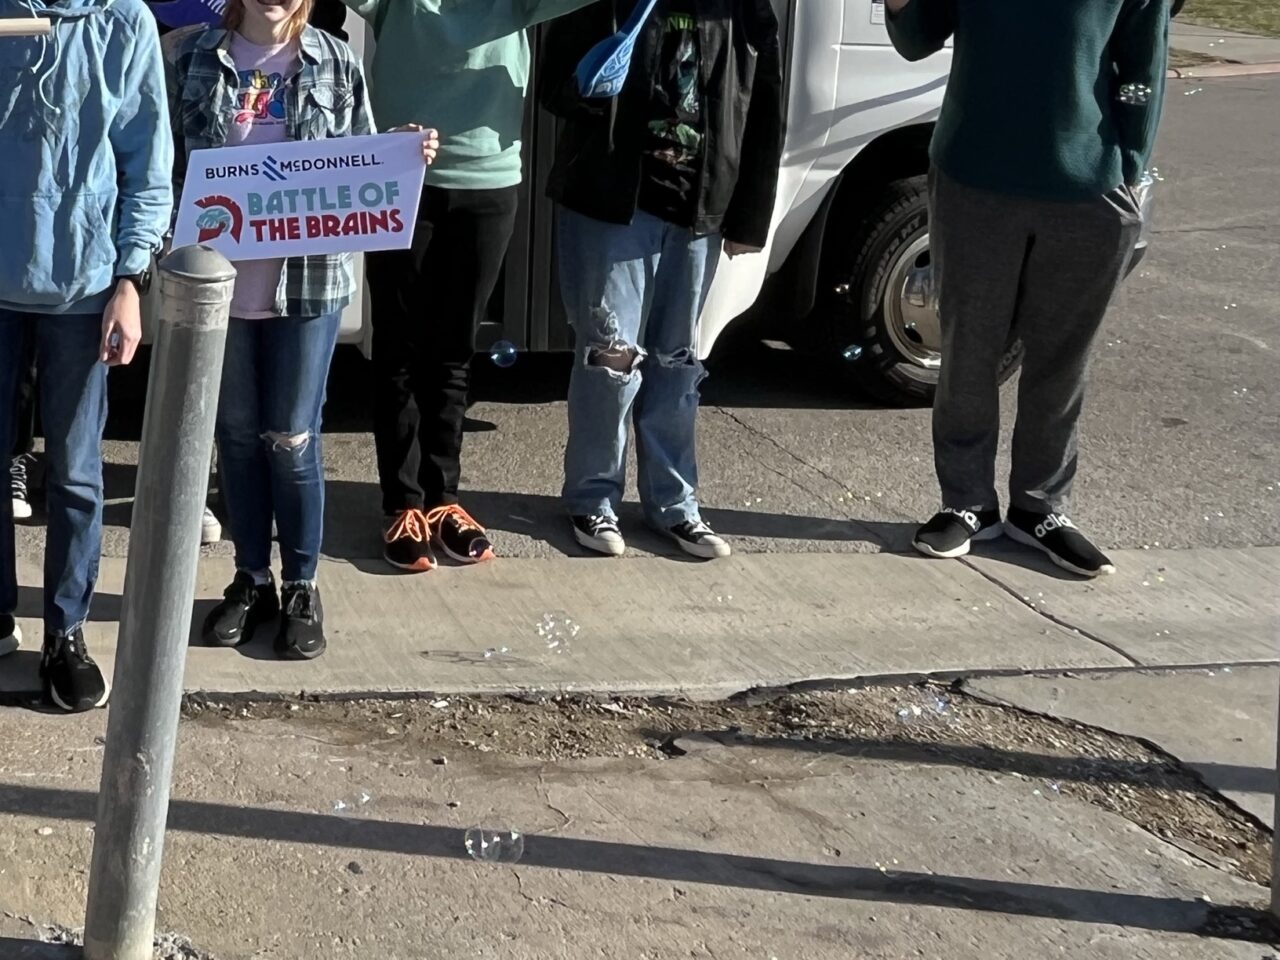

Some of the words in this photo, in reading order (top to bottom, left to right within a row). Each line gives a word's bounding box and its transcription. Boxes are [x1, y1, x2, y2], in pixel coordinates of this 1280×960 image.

[205, 162, 259, 180] BURNS
[247, 185, 352, 216] BATTLE
[358, 181, 400, 207] OF
[249, 216, 301, 243] THE
[305, 208, 403, 239] BRAINS
